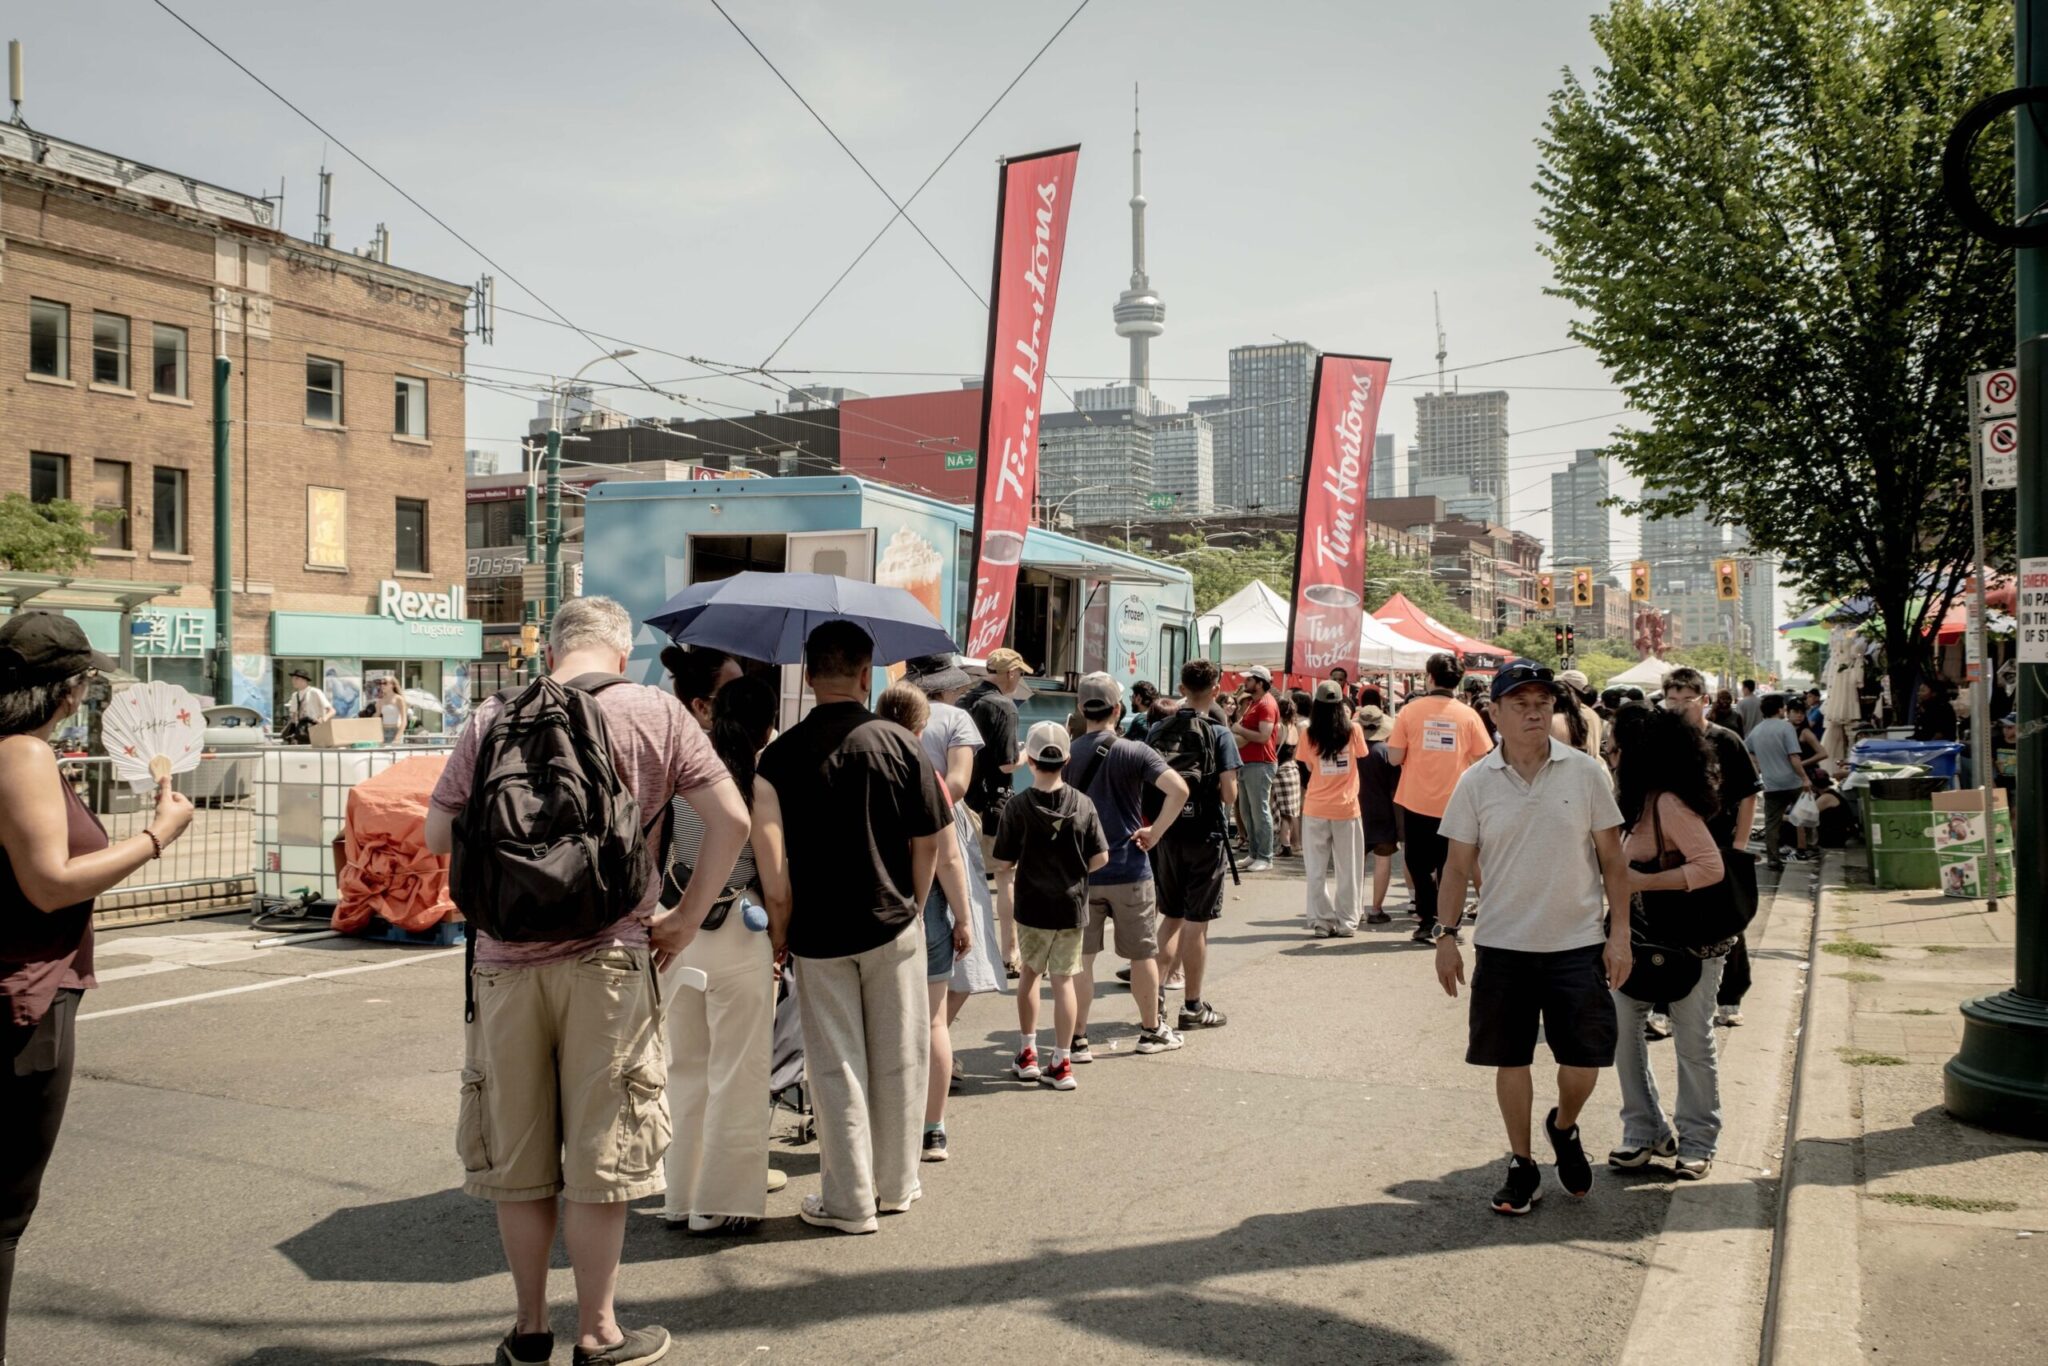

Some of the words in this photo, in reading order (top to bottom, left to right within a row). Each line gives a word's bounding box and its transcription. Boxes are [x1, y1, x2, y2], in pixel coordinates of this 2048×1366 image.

[1322, 374, 1372, 505] Hortons
[947, 455, 965, 467] NA
[995, 405, 1035, 502] Tim
[1316, 508, 1355, 568] Tim
[381, 579, 465, 624] Rexall
[2022, 593, 2033, 606] NO
[1124, 604, 1145, 621] Frozen
[411, 621, 465, 638] Drugstore
[1306, 614, 1344, 642] Tim
[2025, 629, 2035, 642] OF
